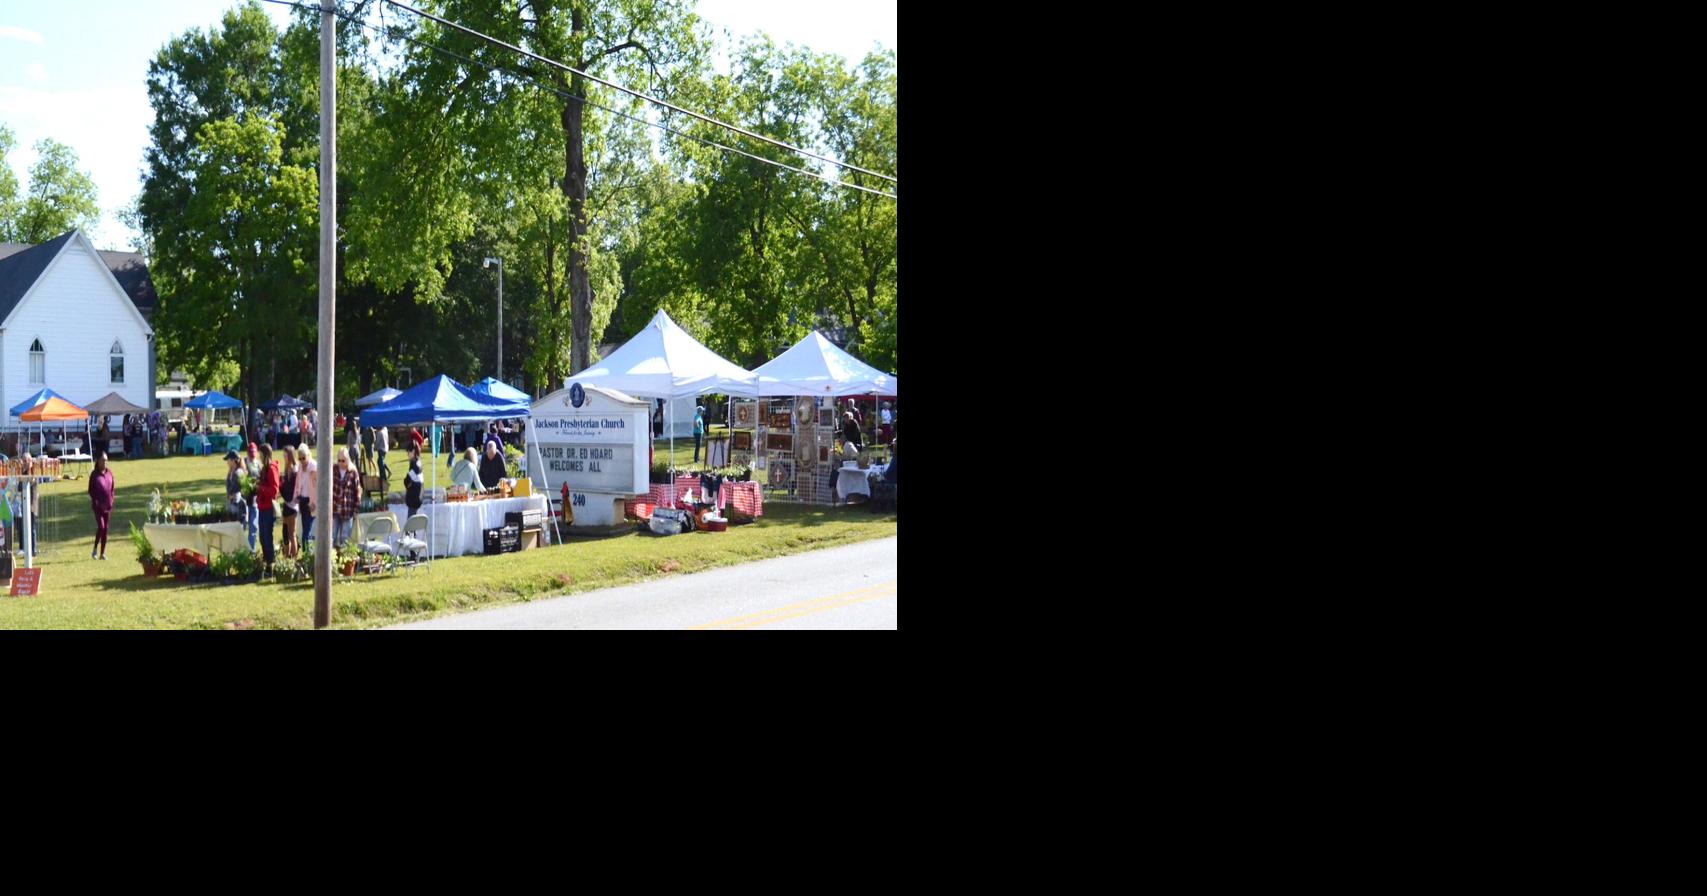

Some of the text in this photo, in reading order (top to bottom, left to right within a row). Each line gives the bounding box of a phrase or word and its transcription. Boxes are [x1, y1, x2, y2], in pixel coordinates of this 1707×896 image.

[535, 418, 625, 430] Jackson Presbyterian Church
[539, 448, 563, 458] PASTOR
[579, 448, 588, 460] ED
[590, 448, 613, 460] HOARD
[550, 460, 601, 472] WELCOMES ALL
[573, 493, 585, 506] 240
